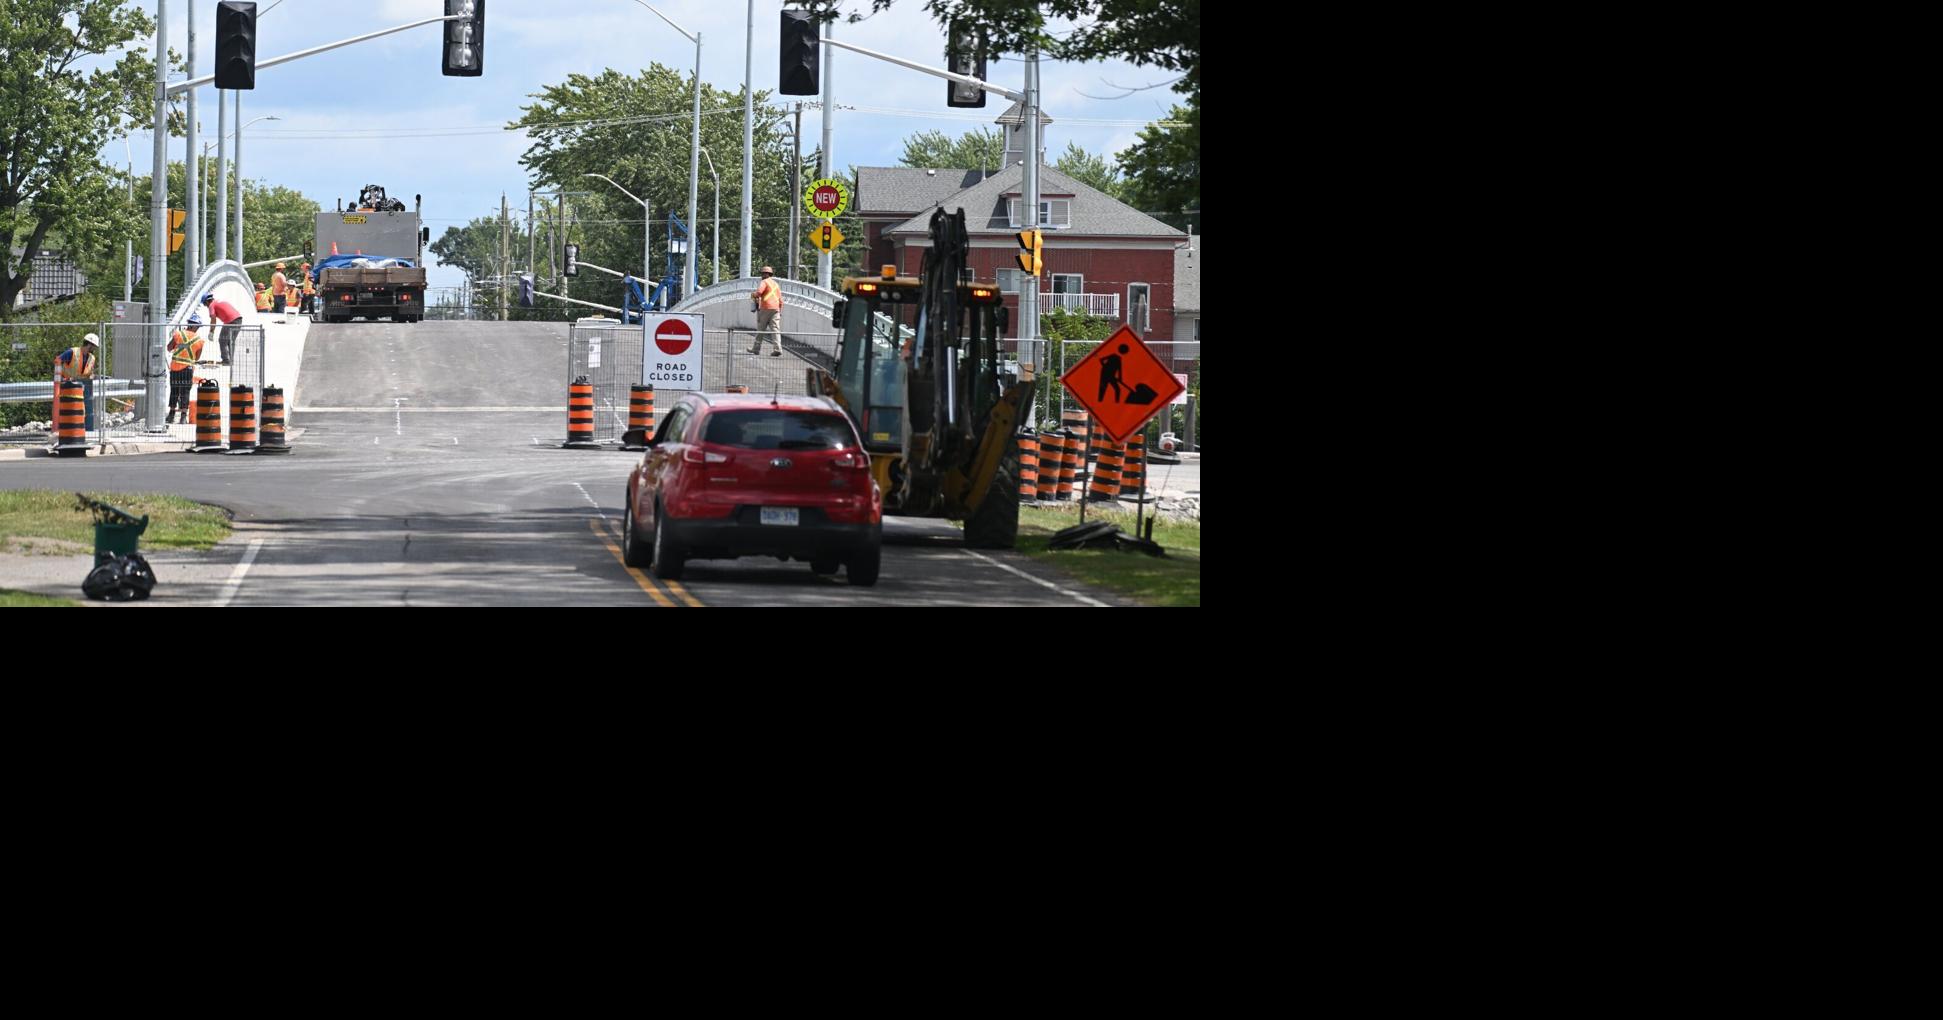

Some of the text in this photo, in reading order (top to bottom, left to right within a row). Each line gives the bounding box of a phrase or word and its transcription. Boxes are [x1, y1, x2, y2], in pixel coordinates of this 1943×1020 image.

[816, 192, 837, 204] NEW
[656, 363, 687, 371] ROAD
[649, 373, 694, 381] CLOSED
